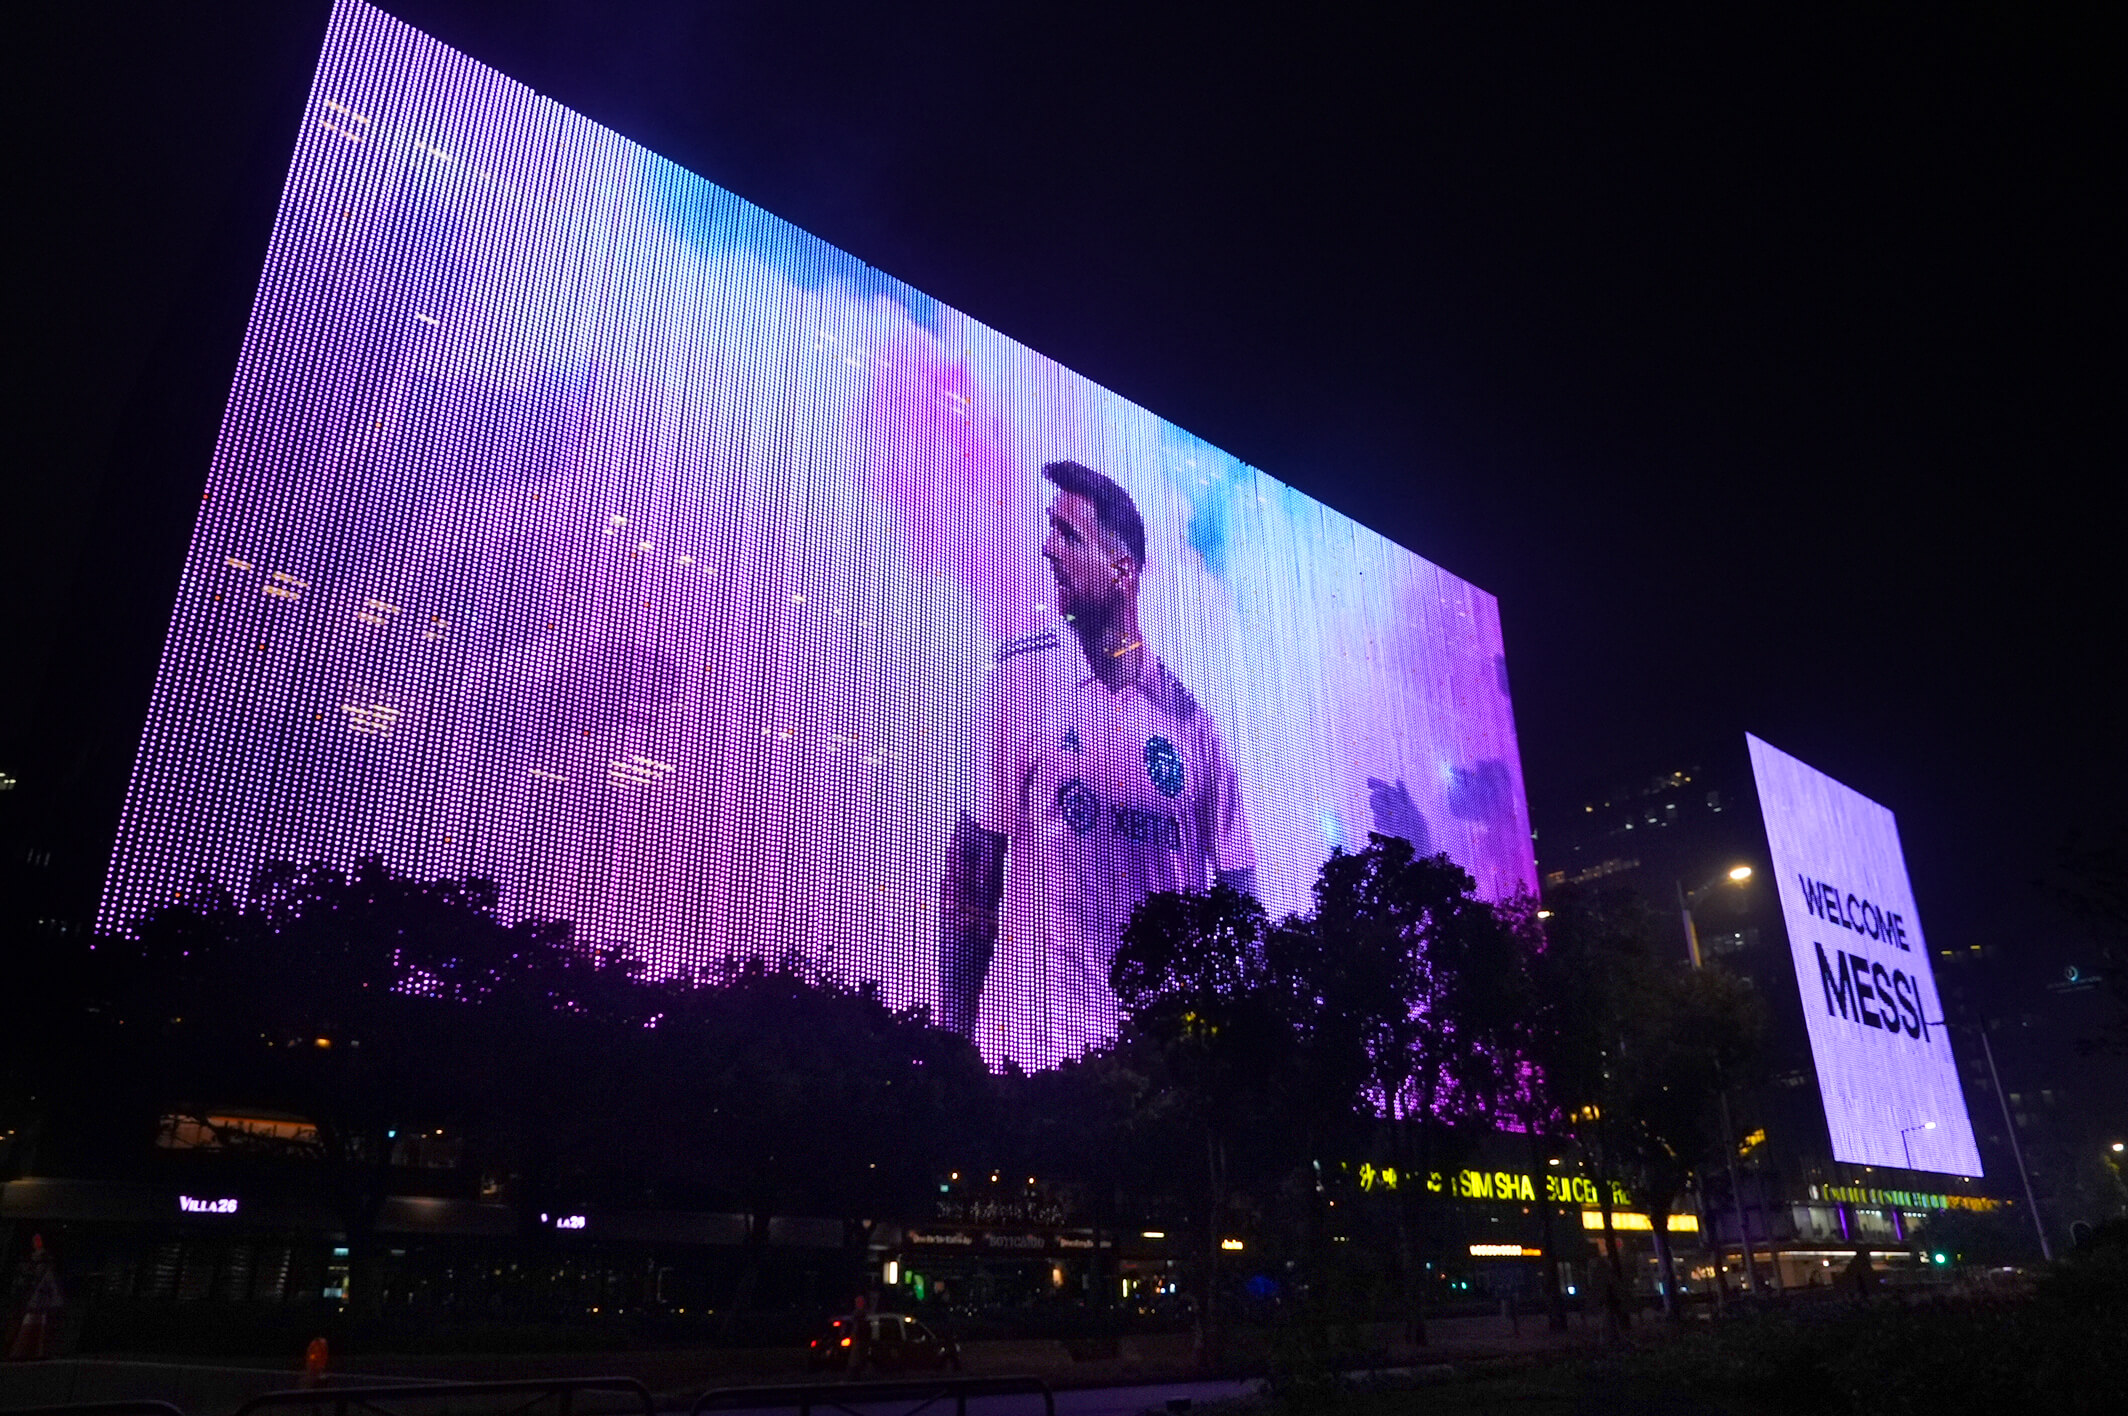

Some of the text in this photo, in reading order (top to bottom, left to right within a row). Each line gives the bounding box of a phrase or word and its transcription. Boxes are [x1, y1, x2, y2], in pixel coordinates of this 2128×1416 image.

[1798, 873, 1911, 952] WELCOME
[1813, 941, 1930, 1043] MESSI
[179, 1195, 238, 1213] VILLA26
[1494, 1171, 1536, 1202] SHA
